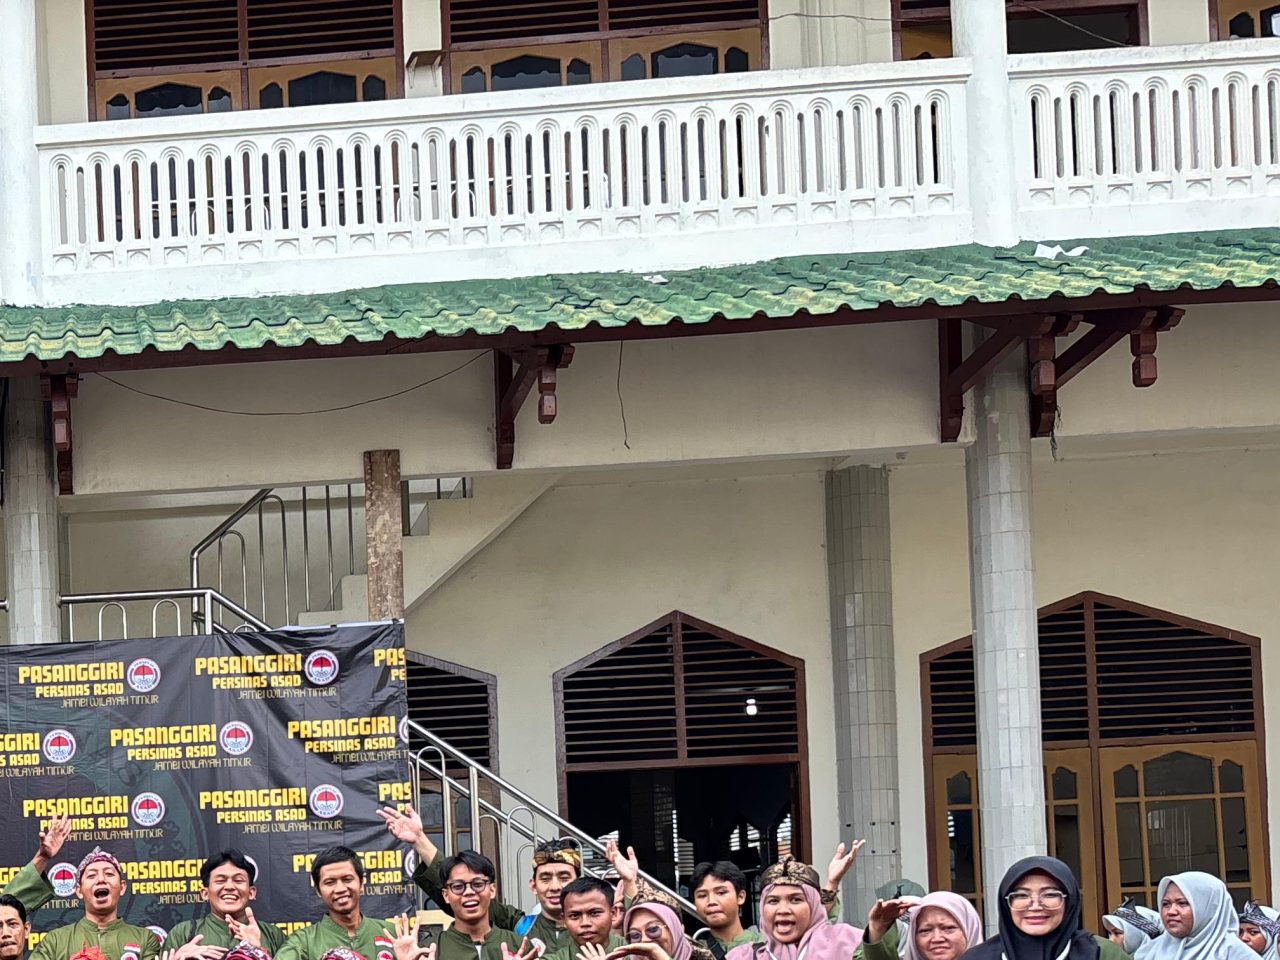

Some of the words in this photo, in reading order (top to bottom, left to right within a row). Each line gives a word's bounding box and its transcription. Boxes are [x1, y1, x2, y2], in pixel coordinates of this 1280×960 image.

[195, 653, 302, 675] PASANGGIRI
[19, 662, 124, 684] PASANGGIRI
[212, 677, 268, 690] PERSINAS
[271, 675, 301, 687] ASAD
[36, 684, 90, 698] PERSINAS
[94, 683, 123, 695] ASAD
[267, 688, 305, 698] WILAYAH
[307, 687, 336, 696] TIMUR
[89, 696, 128, 707] WILAYAH
[130, 695, 159, 704] TIMUR
[288, 716, 395, 739] PASANGGIRI
[110, 724, 216, 746] PASANGGIRI
[305, 739, 360, 753] PERSINAS
[364, 737, 395, 749] ASAD
[10, 753, 39, 766] ASAD
[128, 747, 182, 761] PERSINAS
[186, 745, 216, 758] ASAD
[360, 751, 401, 762] WILAYAH
[182, 759, 220, 770] WILAYAH
[222, 758, 251, 767] TIMUR
[6, 767, 44, 777] WILAYAH
[46, 766, 75, 775] TIMUR
[200, 787, 306, 809] PASANGGIRI
[23, 796, 128, 817] PASANGGIRI
[217, 810, 271, 824] PERSINAS
[275, 808, 306, 821] ASAD
[98, 817, 128, 829] ASAD
[272, 822, 310, 832] WILAYAH
[312, 821, 342, 831] TIMUR
[94, 830, 132, 841] WILAYAH
[135, 829, 163, 838] TIMUR
[371, 871, 402, 884] ASAD
[132, 880, 187, 894] PERSINAS
[367, 885, 407, 895] WILAYAH
[52, 899, 79, 908] TIMUR
